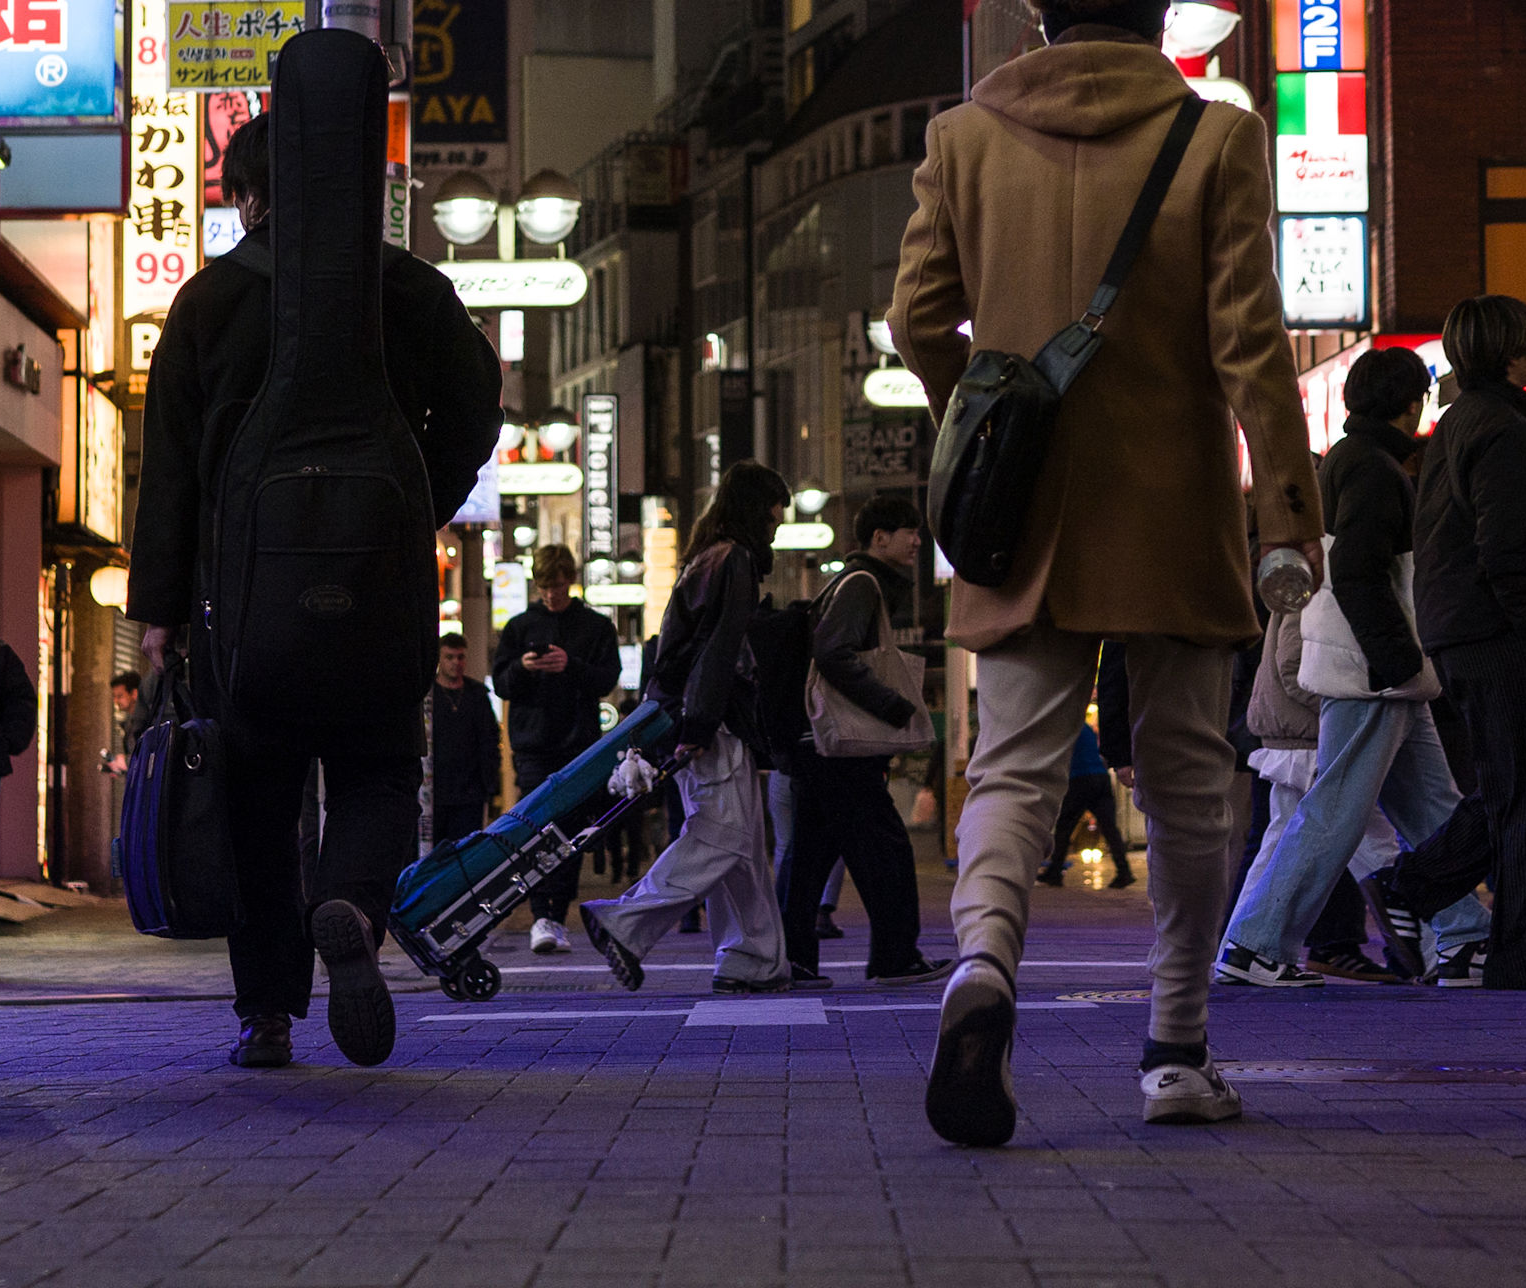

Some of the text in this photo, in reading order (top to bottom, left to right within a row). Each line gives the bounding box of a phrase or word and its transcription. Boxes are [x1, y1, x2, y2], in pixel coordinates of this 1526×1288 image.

[175, 66, 263, 83] サンルイビル
[414, 95, 496, 123] AYA
[135, 252, 185, 285] 99
